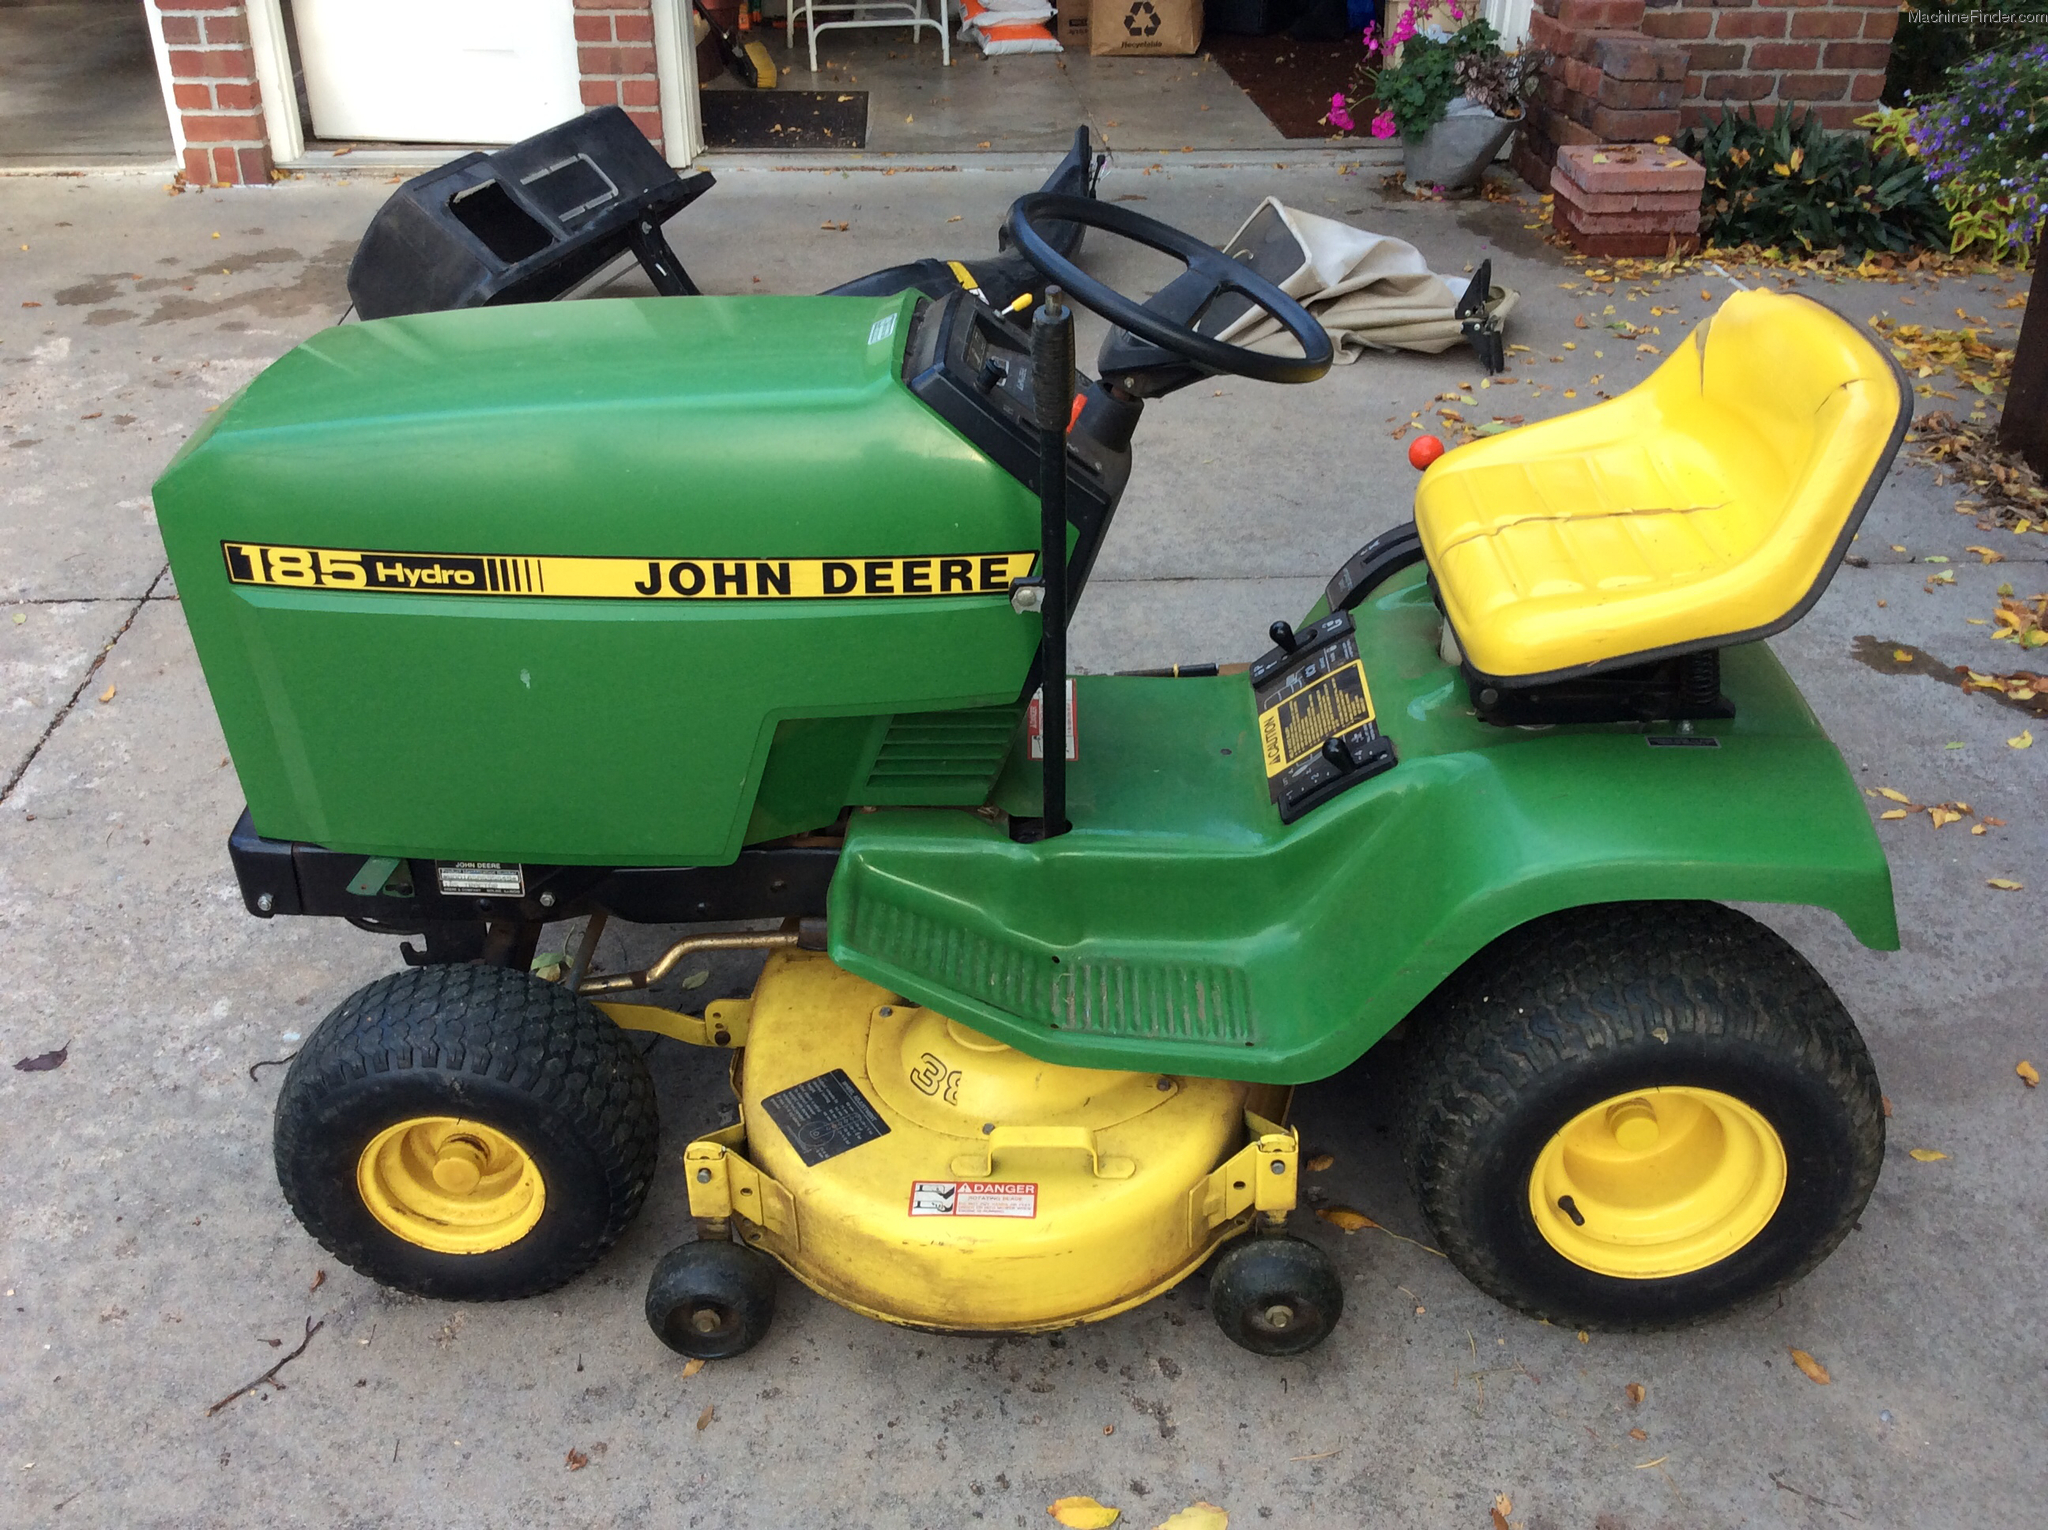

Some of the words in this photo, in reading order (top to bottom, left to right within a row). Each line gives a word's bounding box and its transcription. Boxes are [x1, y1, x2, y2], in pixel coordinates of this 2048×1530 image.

[240, 545, 367, 588] 185
[375, 561, 475, 588] Hydro
[634, 562, 791, 596] JOHN
[822, 557, 1009, 595] DEERE
[1263, 716, 1279, 758] CAUTION
[973, 1184, 1035, 1194] DANGER
